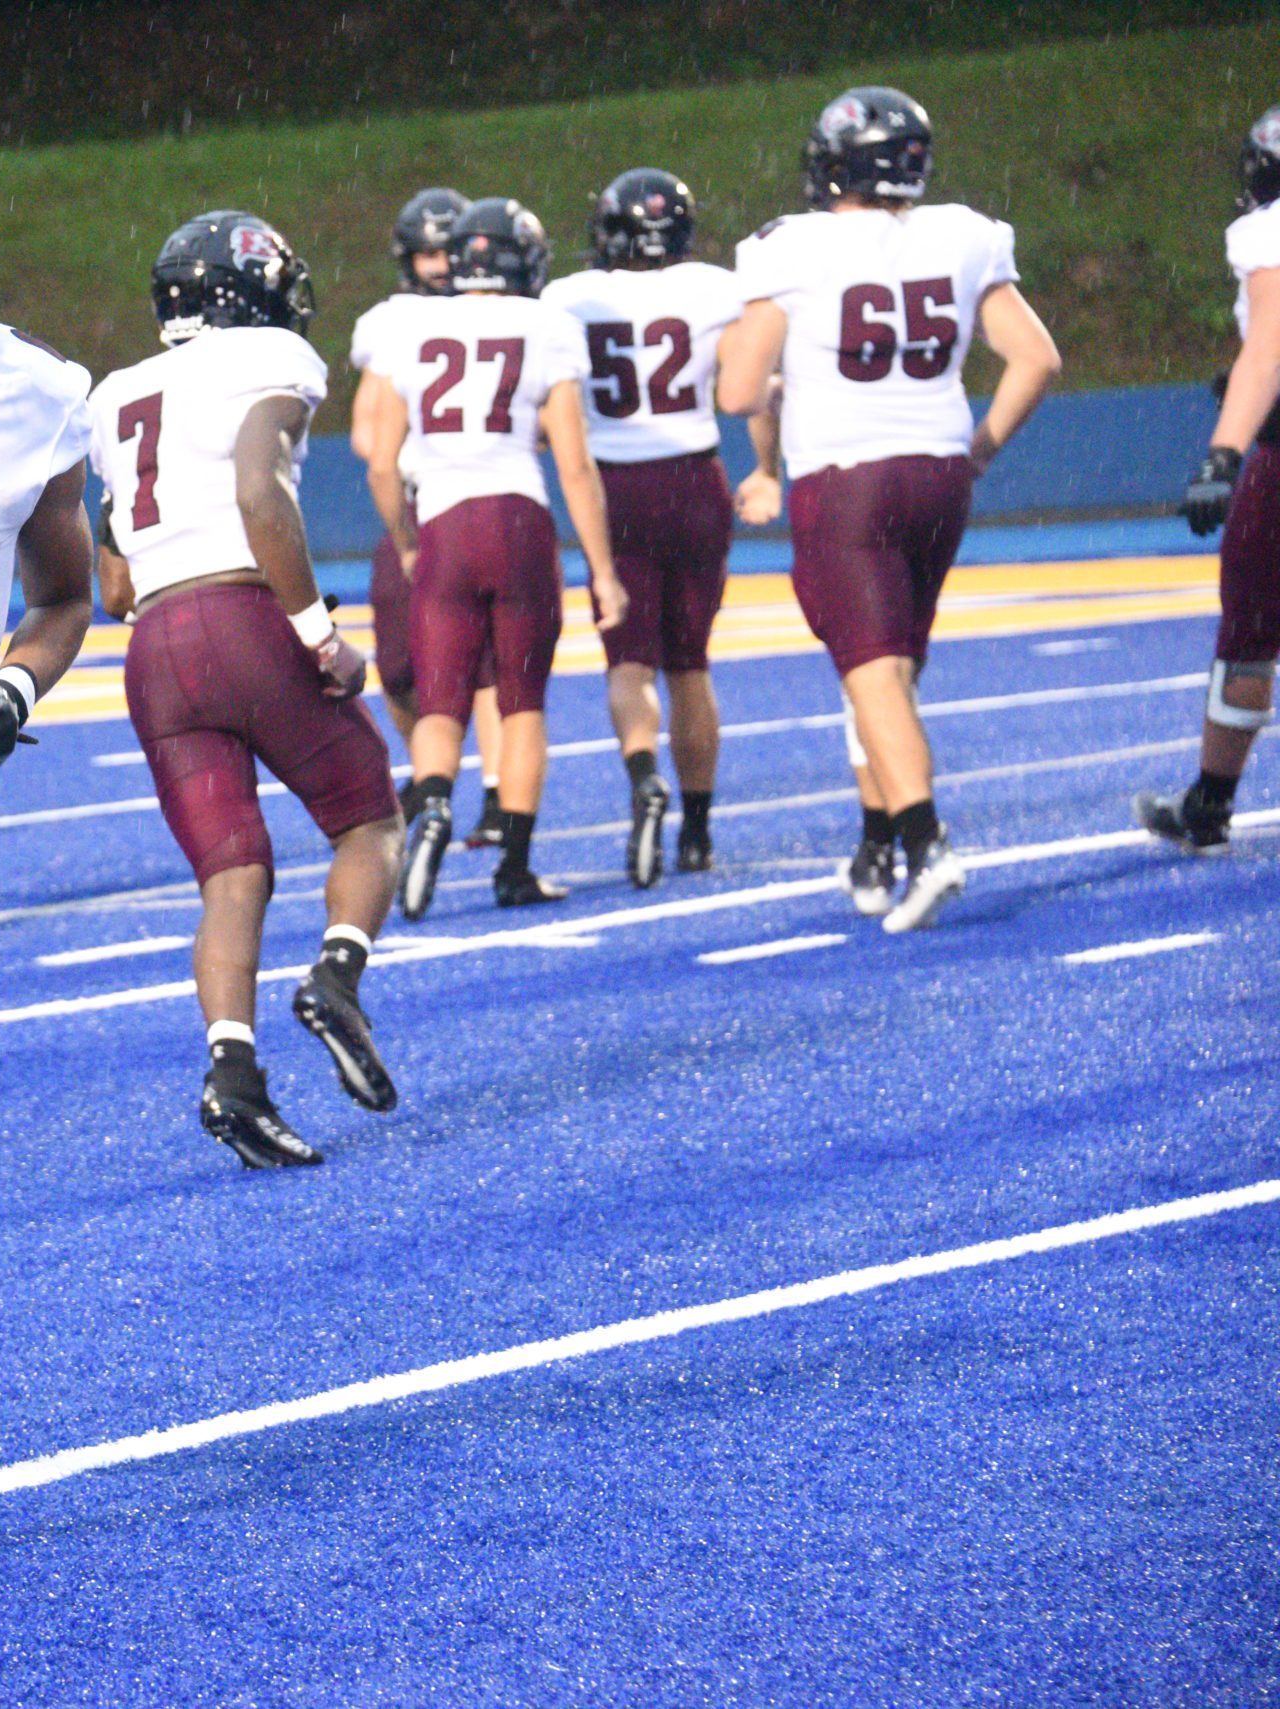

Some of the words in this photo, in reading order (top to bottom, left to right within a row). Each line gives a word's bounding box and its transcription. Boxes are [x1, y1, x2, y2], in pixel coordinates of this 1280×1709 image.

[586, 318, 698, 420] 52
[837, 276, 960, 383] 65
[420, 338, 525, 435] 27
[117, 392, 163, 532] 7
